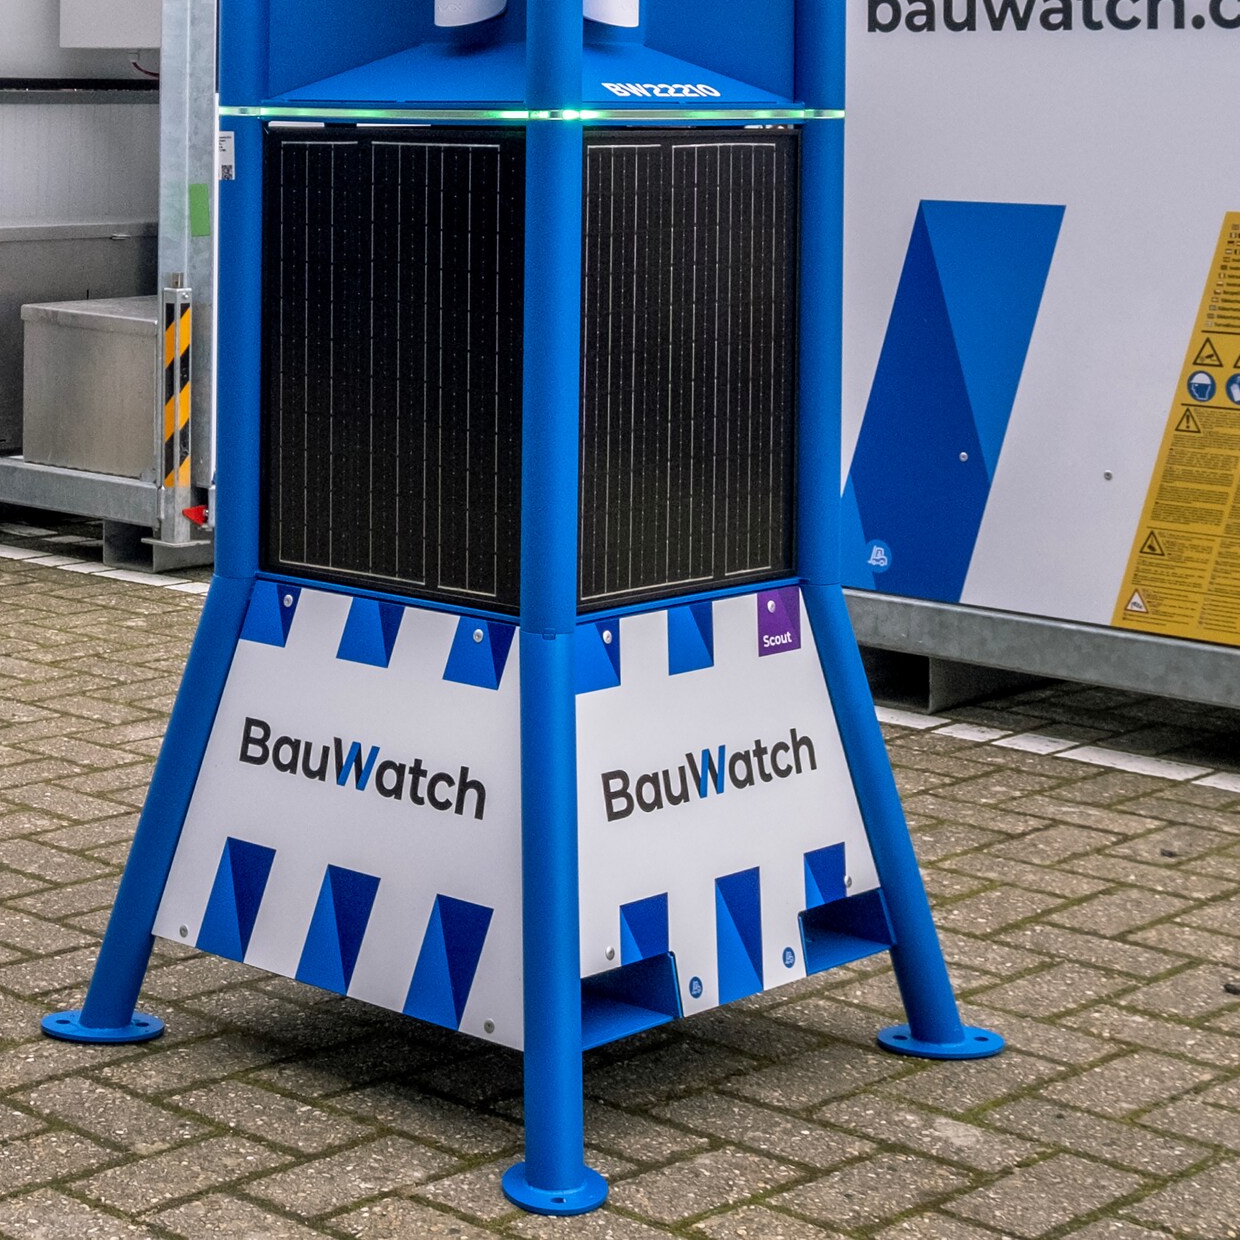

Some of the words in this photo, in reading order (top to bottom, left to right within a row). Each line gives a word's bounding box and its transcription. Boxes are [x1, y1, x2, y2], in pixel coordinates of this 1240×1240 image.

[601, 82, 721, 97] BW22210
[763, 631, 792, 648] Scout
[239, 717, 486, 820] BauWatch
[601, 728, 817, 822] BauWatch
